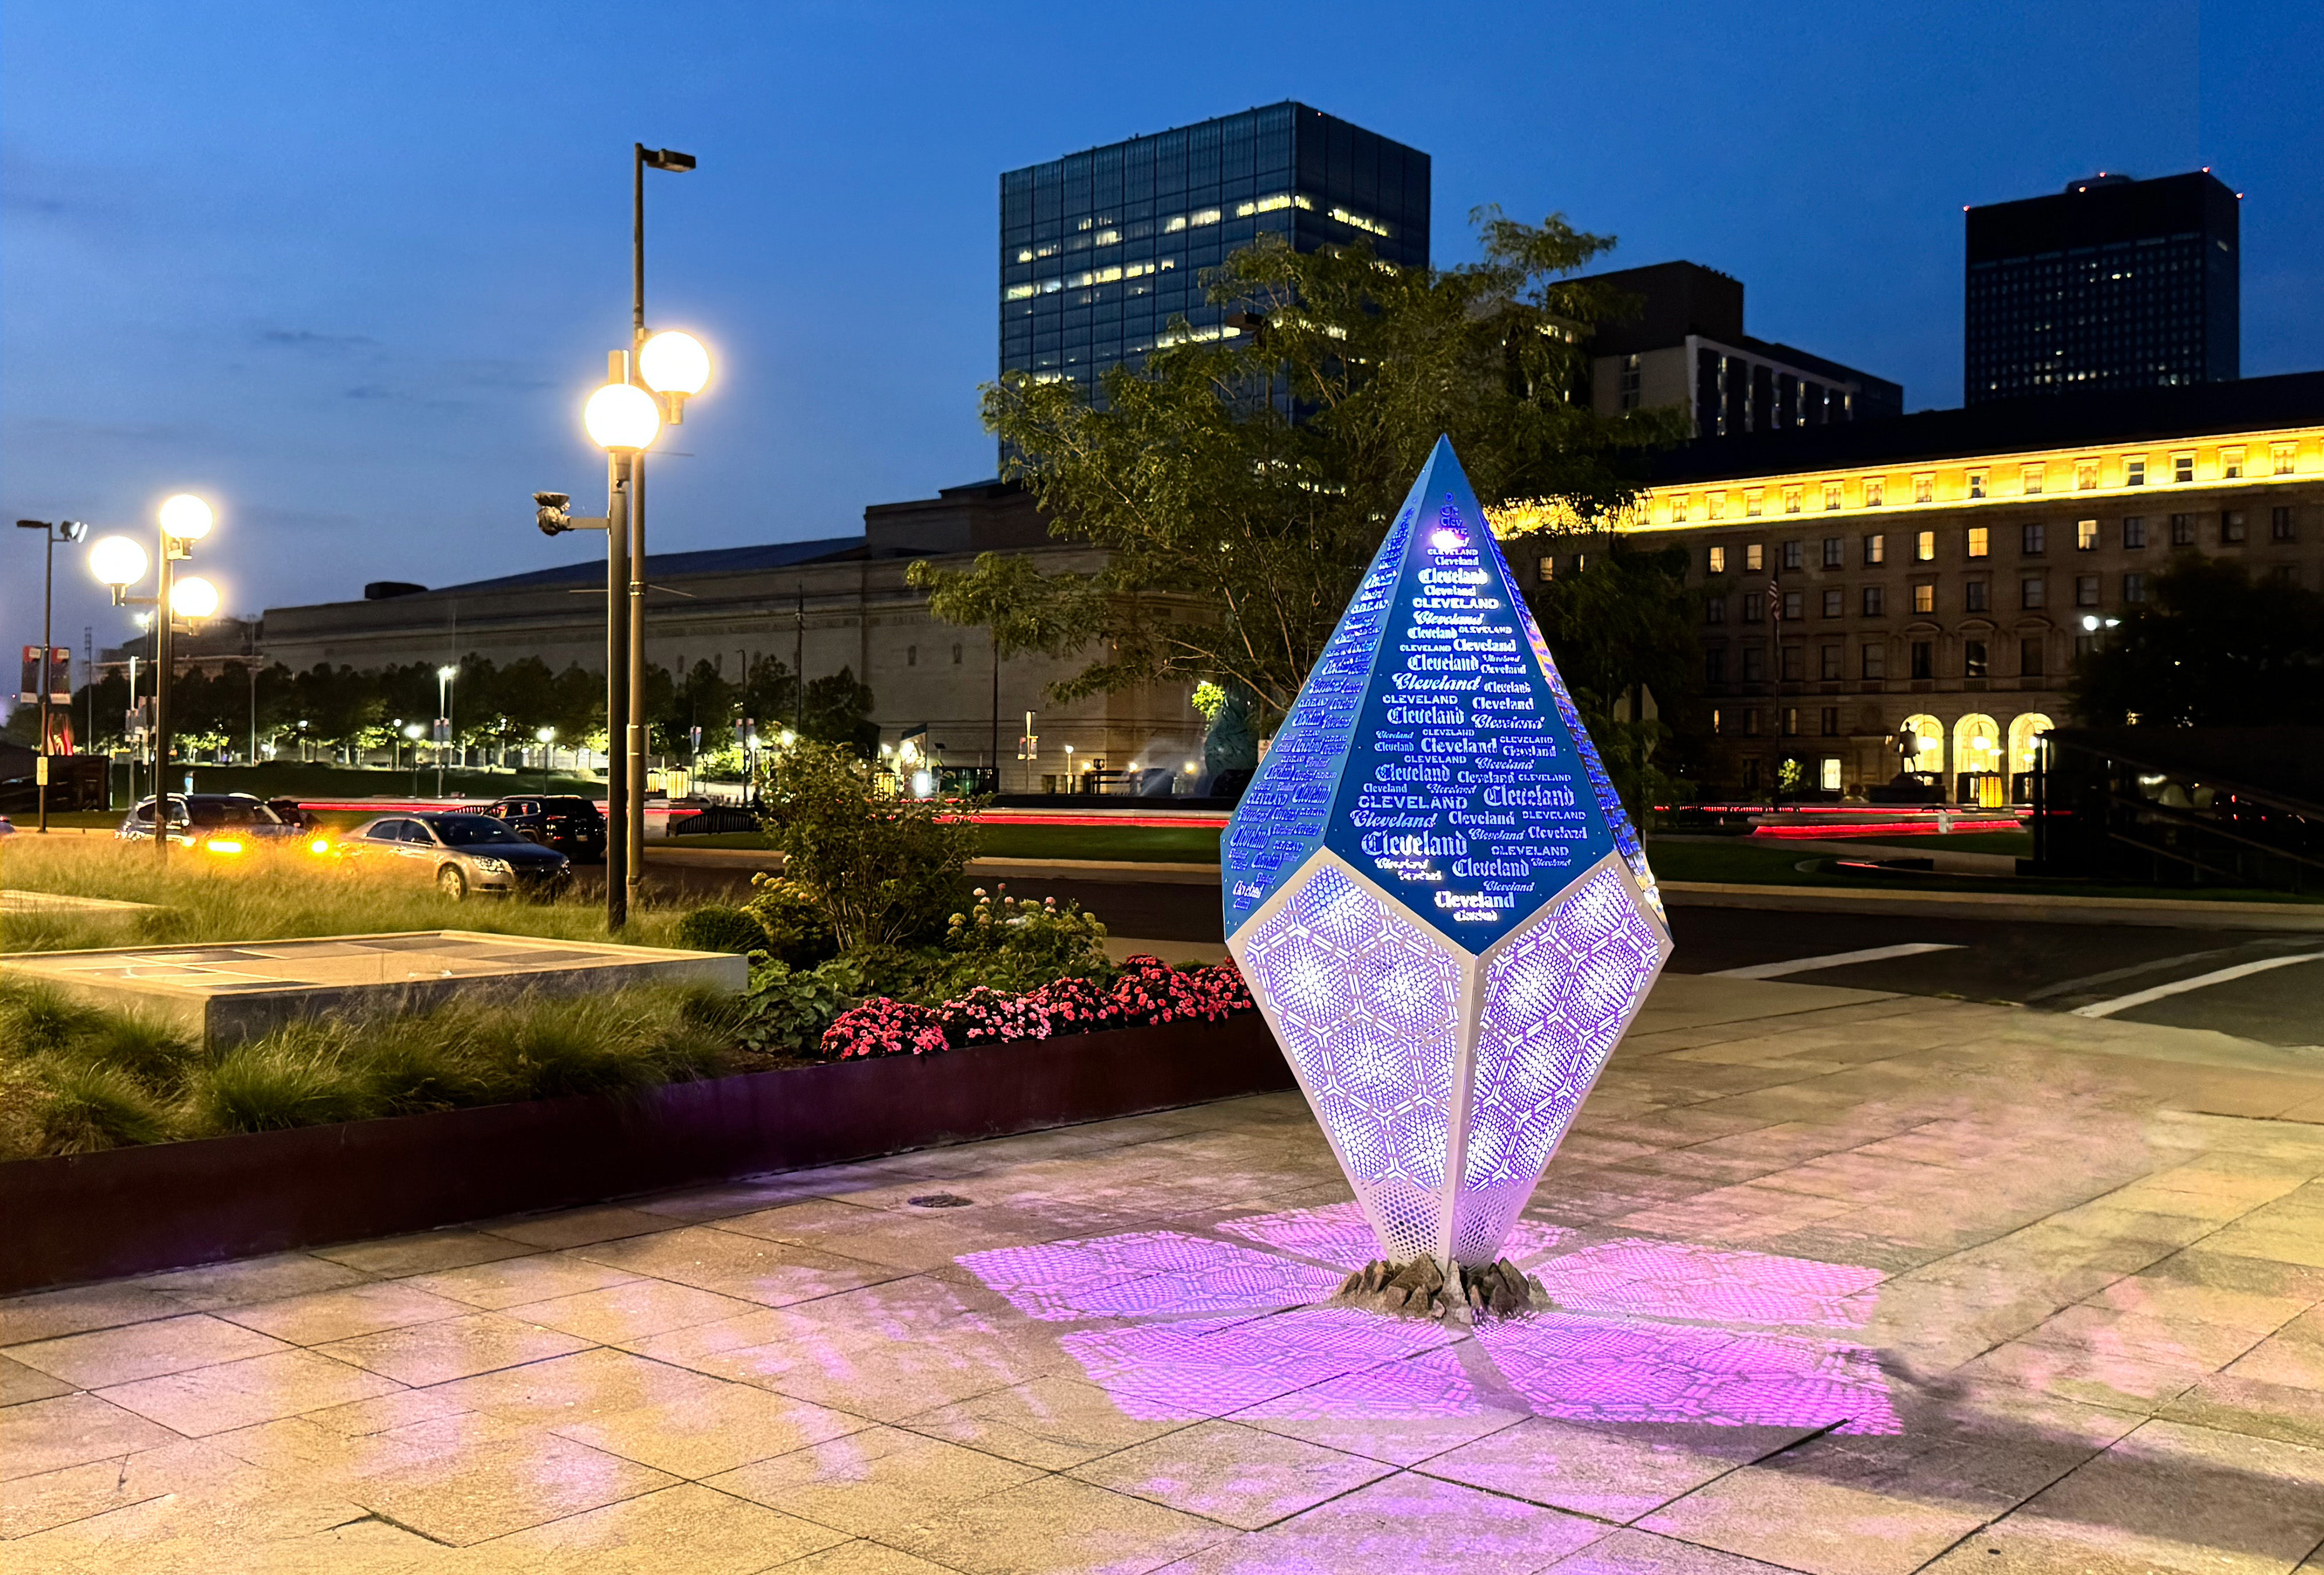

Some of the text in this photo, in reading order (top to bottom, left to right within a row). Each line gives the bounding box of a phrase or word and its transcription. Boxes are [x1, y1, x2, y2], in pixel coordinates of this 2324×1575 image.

[1435, 557, 1479, 565] Cleveland
[1418, 567, 1488, 585] Cleveland
[1423, 585, 1476, 596] Cleveland
[1412, 597, 1500, 609] CLEVELAND
[1413, 611, 1484, 625] Cleveland
[1407, 627, 1458, 639] Cleveland
[1453, 639, 1516, 652] Cleveland
[1407, 654, 1479, 671] Cleveland
[1480, 664, 1526, 674] Cleveland
[1392, 673, 1532, 693] Cleveland Cleveland
[1382, 695, 1534, 710] CLEVELAND Cleveland
[1387, 706, 1465, 725] Cleveland
[1375, 731, 1414, 739] Cleveland
[1374, 736, 1554, 754] Cleveland Cleveland CLEVELAND
[1502, 745, 1556, 757] Cleveland
[1404, 756, 1535, 770] CLEVELAND Cleveland
[1375, 763, 1572, 784] Cleveland Cleveland CLEVELAND
[1246, 793, 1289, 805] CLEVELAND
[1363, 783, 1408, 793] Cleveland
[1483, 784, 1575, 807] Cleveland
[1358, 795, 1468, 810] CLEVELAND
[1350, 810, 1587, 828] Cleveland Cleveland CLEVELAND
[1468, 826, 1588, 840] Cleveland Cleveland
[1361, 829, 1569, 856] Cleveland CLEVELAND
[1452, 857, 1530, 877] Cleveland
[1483, 880, 1536, 892] Cleveland
[1434, 890, 1515, 908] Cleveland
